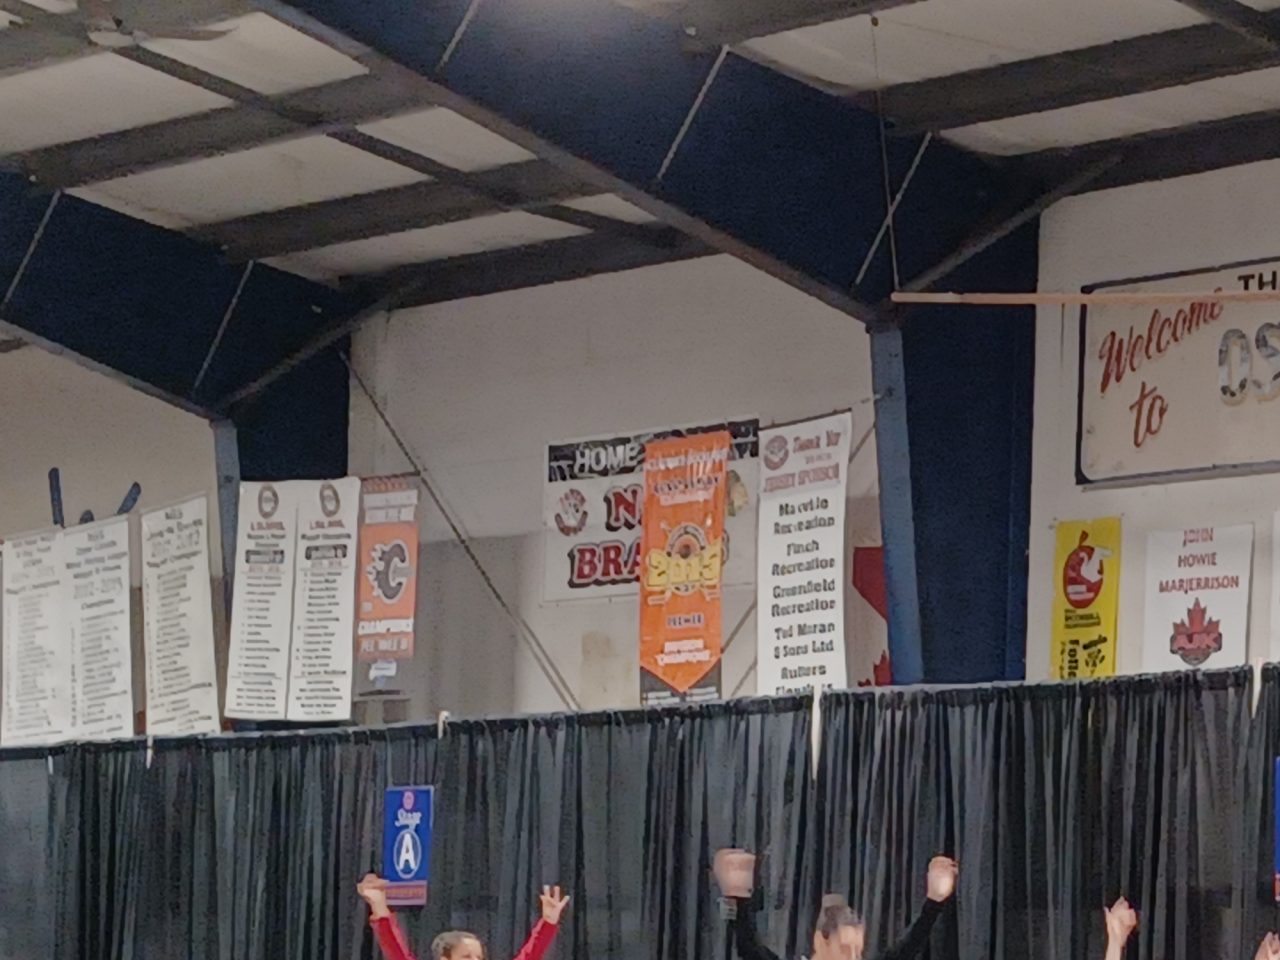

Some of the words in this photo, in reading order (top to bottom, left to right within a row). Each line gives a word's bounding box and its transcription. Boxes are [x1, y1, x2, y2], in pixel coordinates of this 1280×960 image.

[1098, 287, 1224, 394] Welcome
[1129, 381, 1168, 449] to
[1178, 552, 1217, 567] HOWIE
[399, 833, 416, 870] A
